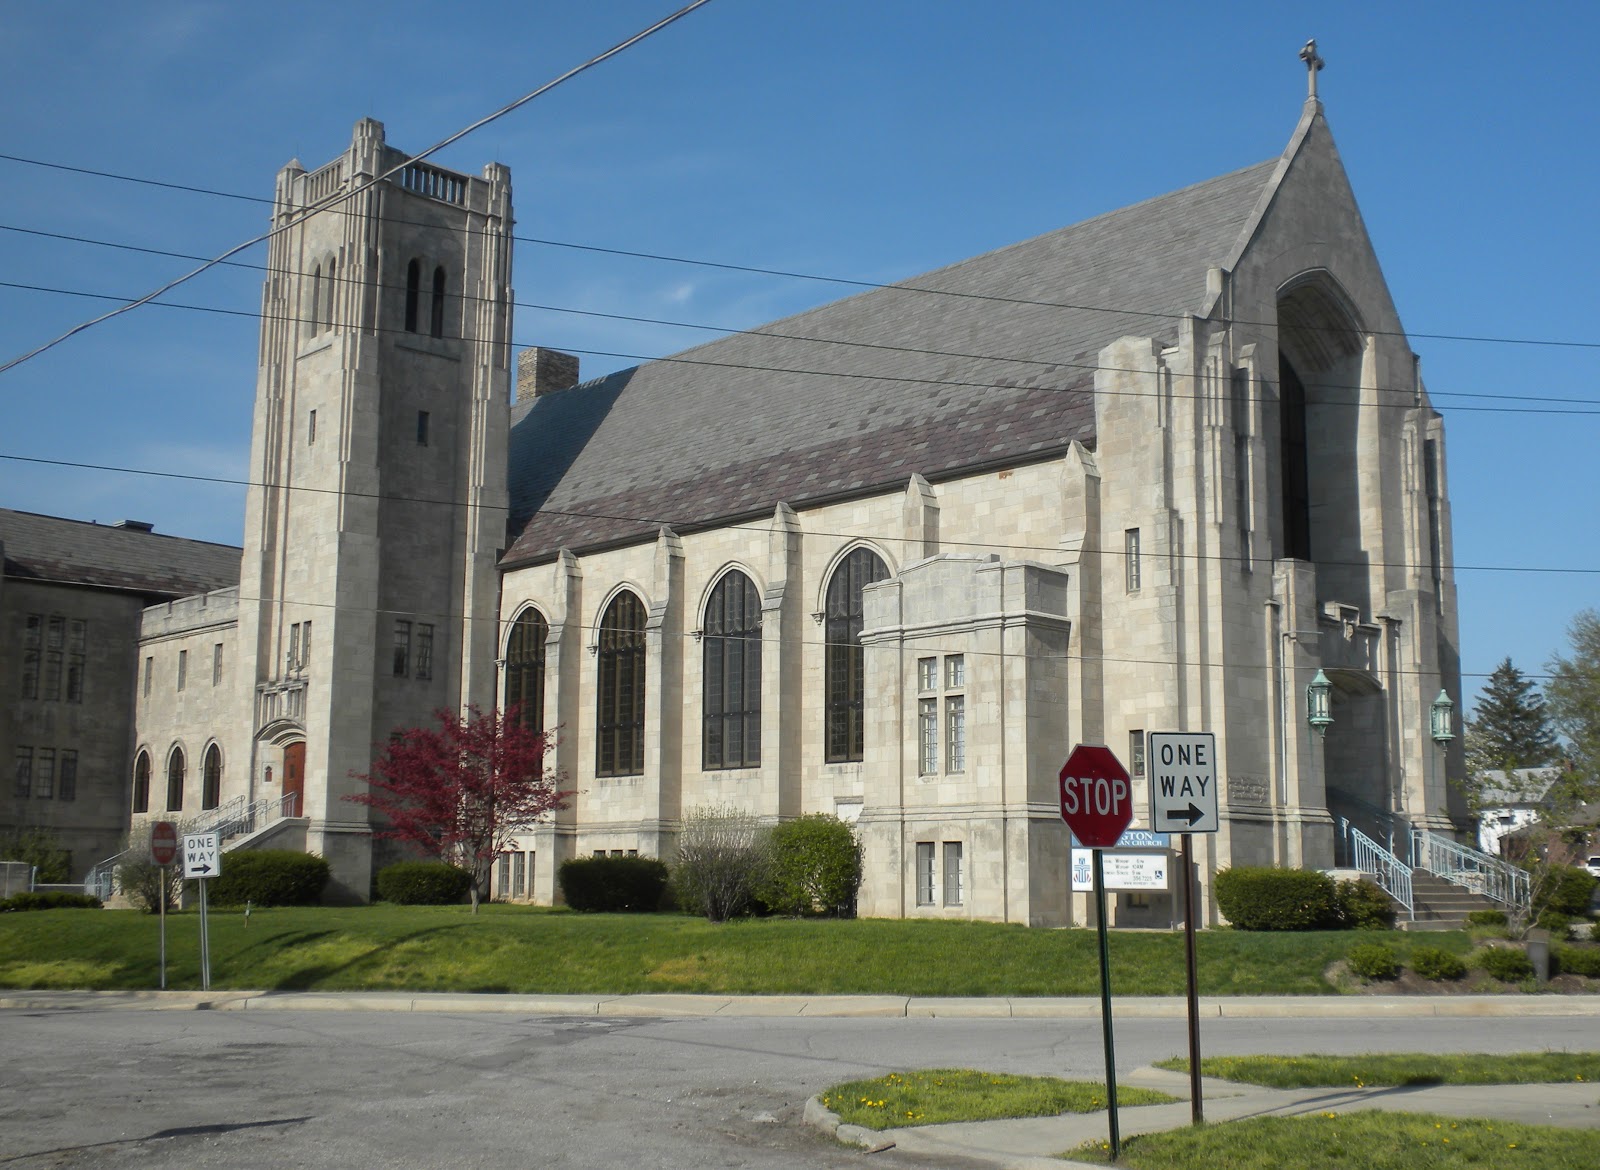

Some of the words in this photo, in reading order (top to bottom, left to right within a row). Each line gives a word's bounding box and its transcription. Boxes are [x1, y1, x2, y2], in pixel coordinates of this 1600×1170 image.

[1161, 744, 1207, 766] ONE
[1064, 776, 1127, 816] STOP
[1161, 775, 1210, 798] WAY
[188, 837, 213, 849] ONE
[187, 851, 215, 863] WAY
